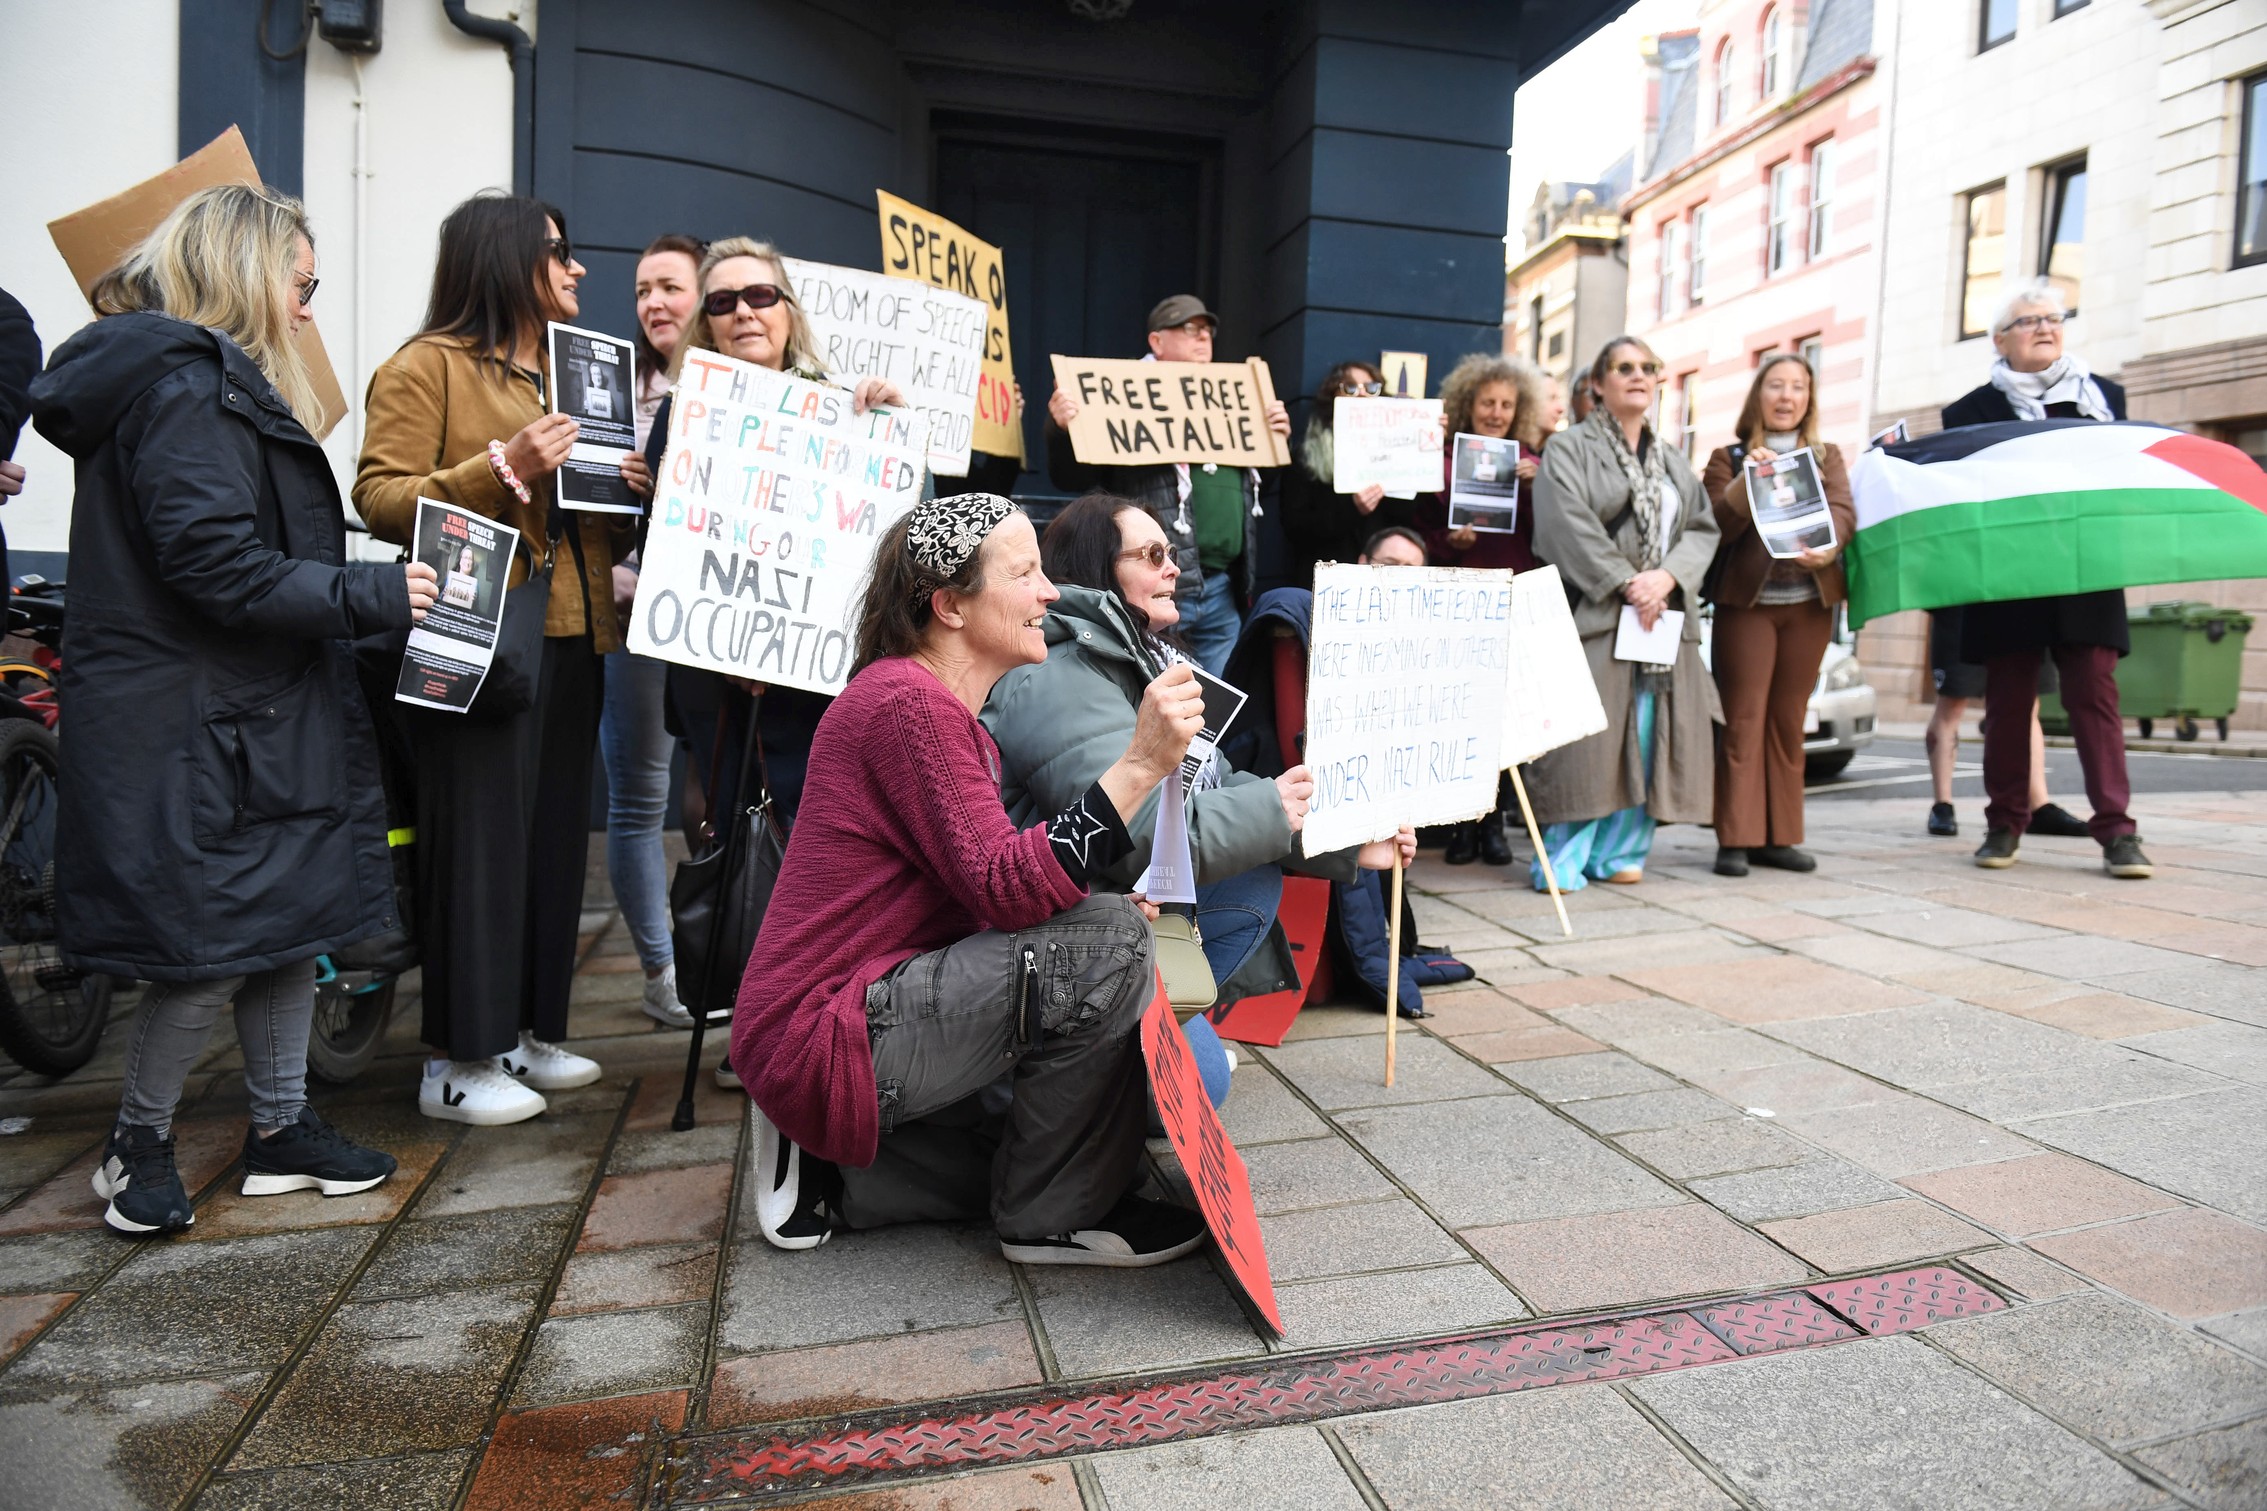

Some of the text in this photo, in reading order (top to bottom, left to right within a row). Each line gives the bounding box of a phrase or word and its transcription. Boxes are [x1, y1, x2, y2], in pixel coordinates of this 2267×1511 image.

[890, 214, 979, 298] SPEAK
[790, 276, 986, 350] EDOM OF SPEECH
[828, 334, 975, 398] RIGHT WE ALL
[1077, 372, 1250, 411] FREE FREE
[672, 449, 713, 496] ON
[682, 400, 794, 457] PEOPLE
[801, 429, 915, 493] INFORMED
[442, 522, 468, 540] UNDER
[469, 532, 496, 551] THREAT
[447, 513, 494, 540] FREE SPEECH
[664, 496, 827, 569] DURING OUR
[700, 549, 814, 614] NAZI
[1318, 585, 1351, 624] THE
[1356, 586, 1400, 623] LAST
[1407, 584, 1444, 621] TIME
[1446, 589, 1510, 624] PEOPLE
[648, 588, 847, 684] OCCUPATIO
[1312, 640, 1352, 679] WERE
[1313, 696, 1343, 739] WAS
[1404, 685, 1424, 728] WE
[1429, 682, 1472, 724] WERE
[1310, 737, 1478, 813] UNDER NAZI RULE
